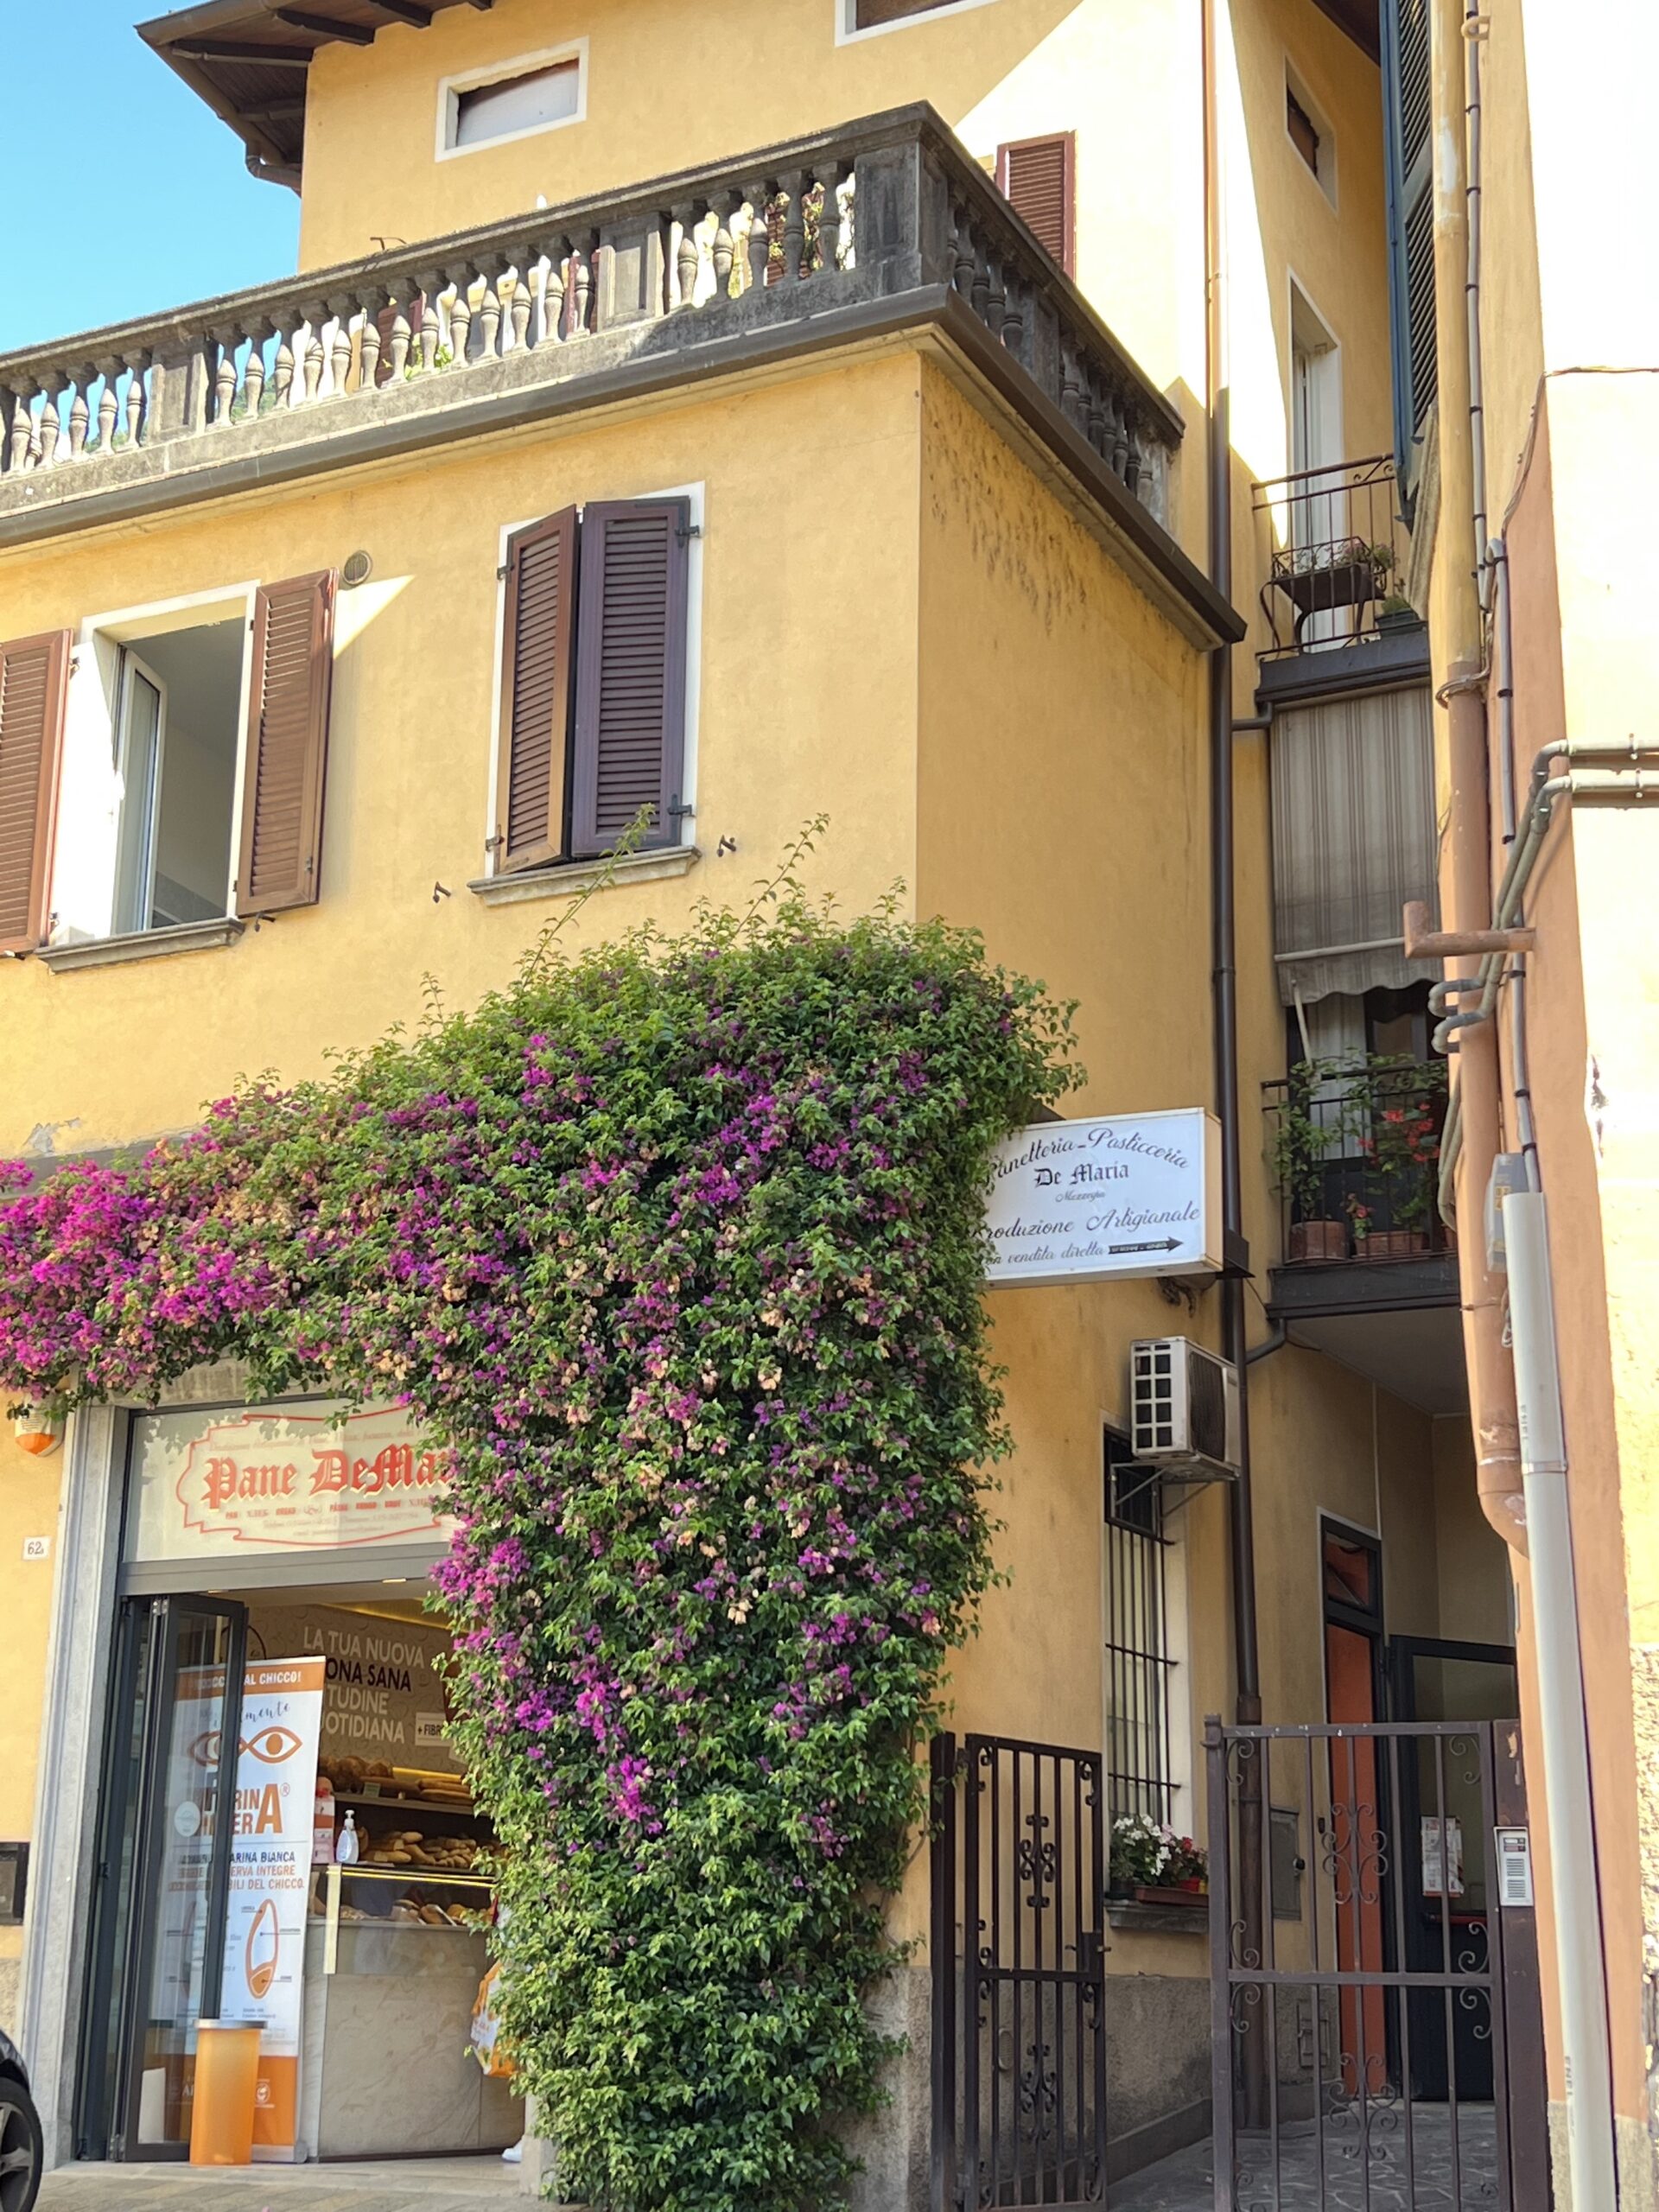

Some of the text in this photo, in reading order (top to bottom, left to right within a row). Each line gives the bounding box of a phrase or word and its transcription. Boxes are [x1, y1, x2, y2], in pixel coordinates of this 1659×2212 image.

[1034, 1160, 1129, 1187] De Maria
[973, 1200, 1199, 1239] roduzione Artigianale
[1007, 1245, 1055, 1263] vendita
[1061, 1242, 1104, 1259] diretta
[201, 1443, 458, 1510] Pane DeMa
[303, 1626, 425, 1669] LA TUA NUOVA
[244, 1671, 302, 1686] AL CHICCO!
[326, 1657, 412, 1692] ONA SANA
[327, 1685, 389, 1715] TUDINE
[325, 1711, 405, 1745] OTIDIANA
[231, 1851, 296, 1863] ARINA BIANCA
[257, 1865, 296, 1876] INTEGRE
[248, 1878, 265, 1890] DEL
